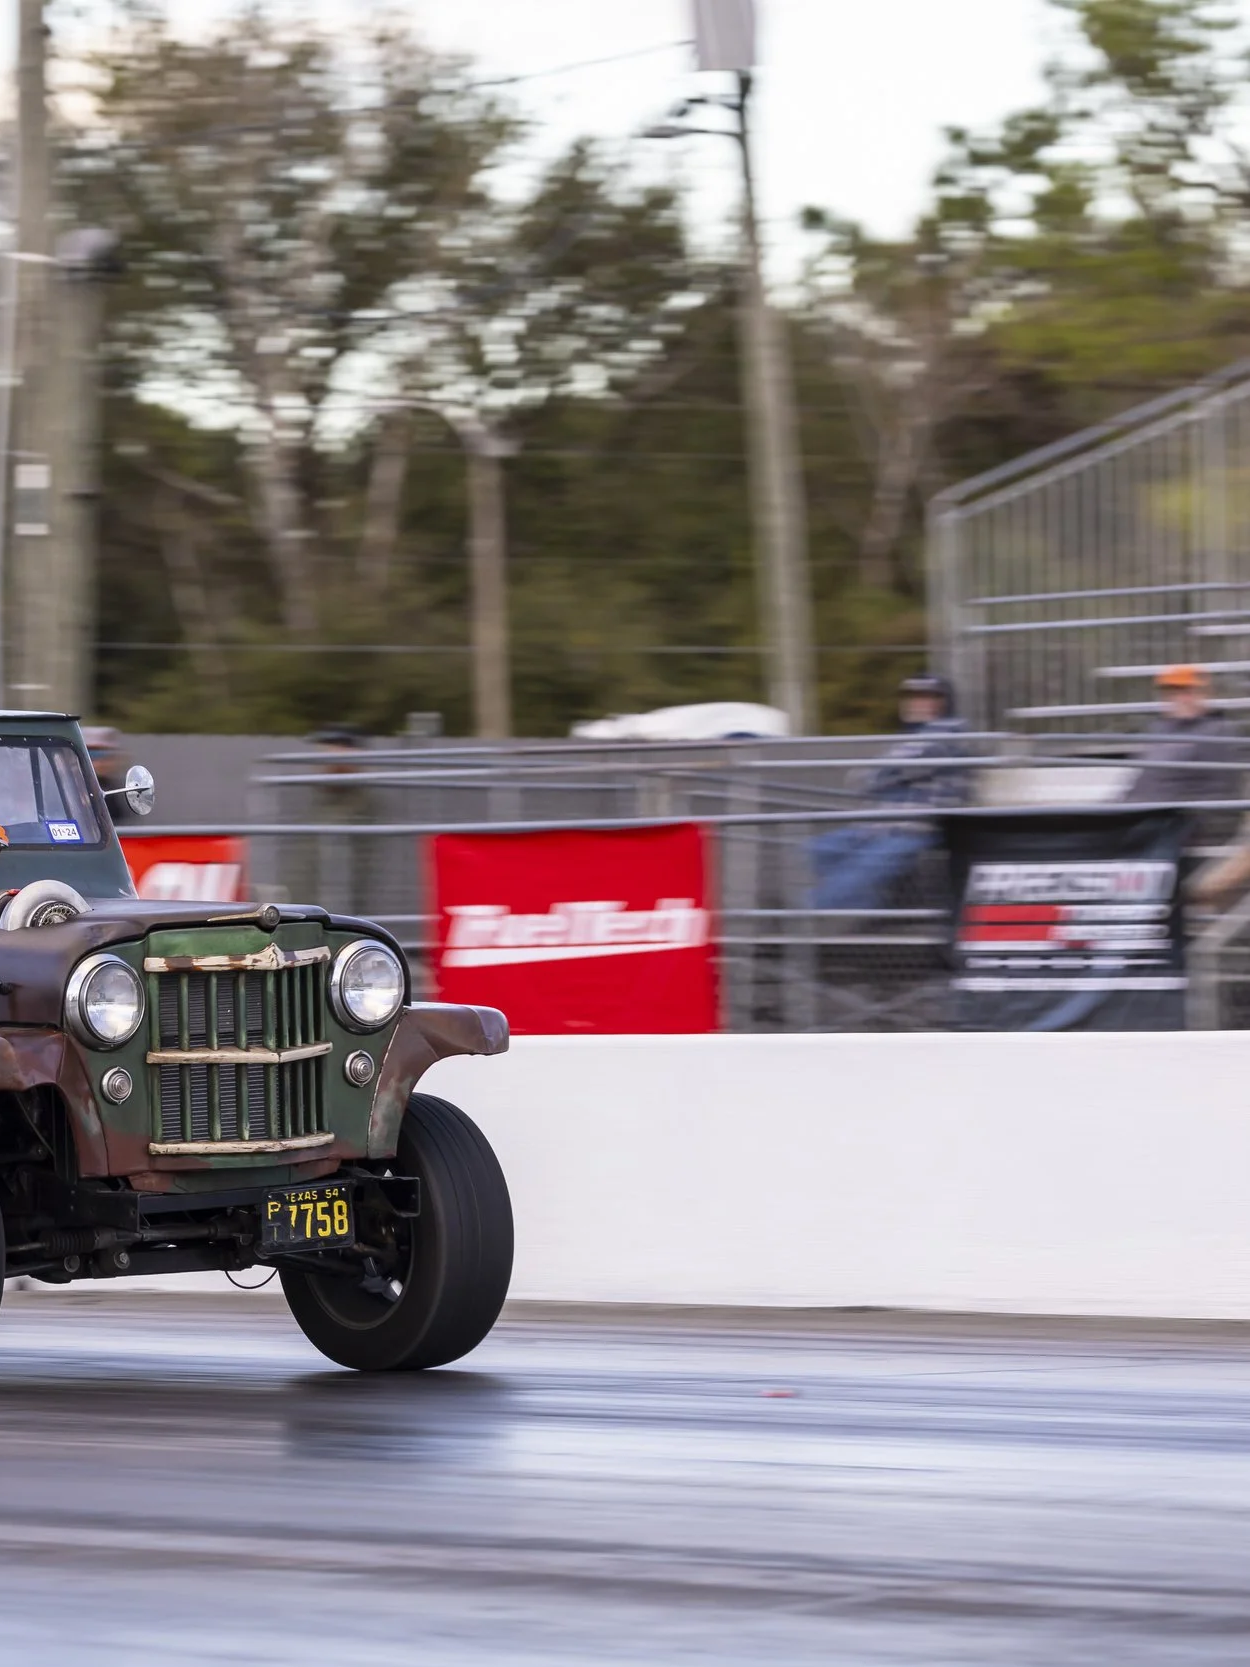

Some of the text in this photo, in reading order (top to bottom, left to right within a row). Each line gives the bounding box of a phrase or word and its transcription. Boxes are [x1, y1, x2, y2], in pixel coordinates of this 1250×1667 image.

[285, 1188, 339, 1202] TEXAS 54
[268, 1202, 281, 1220] P
